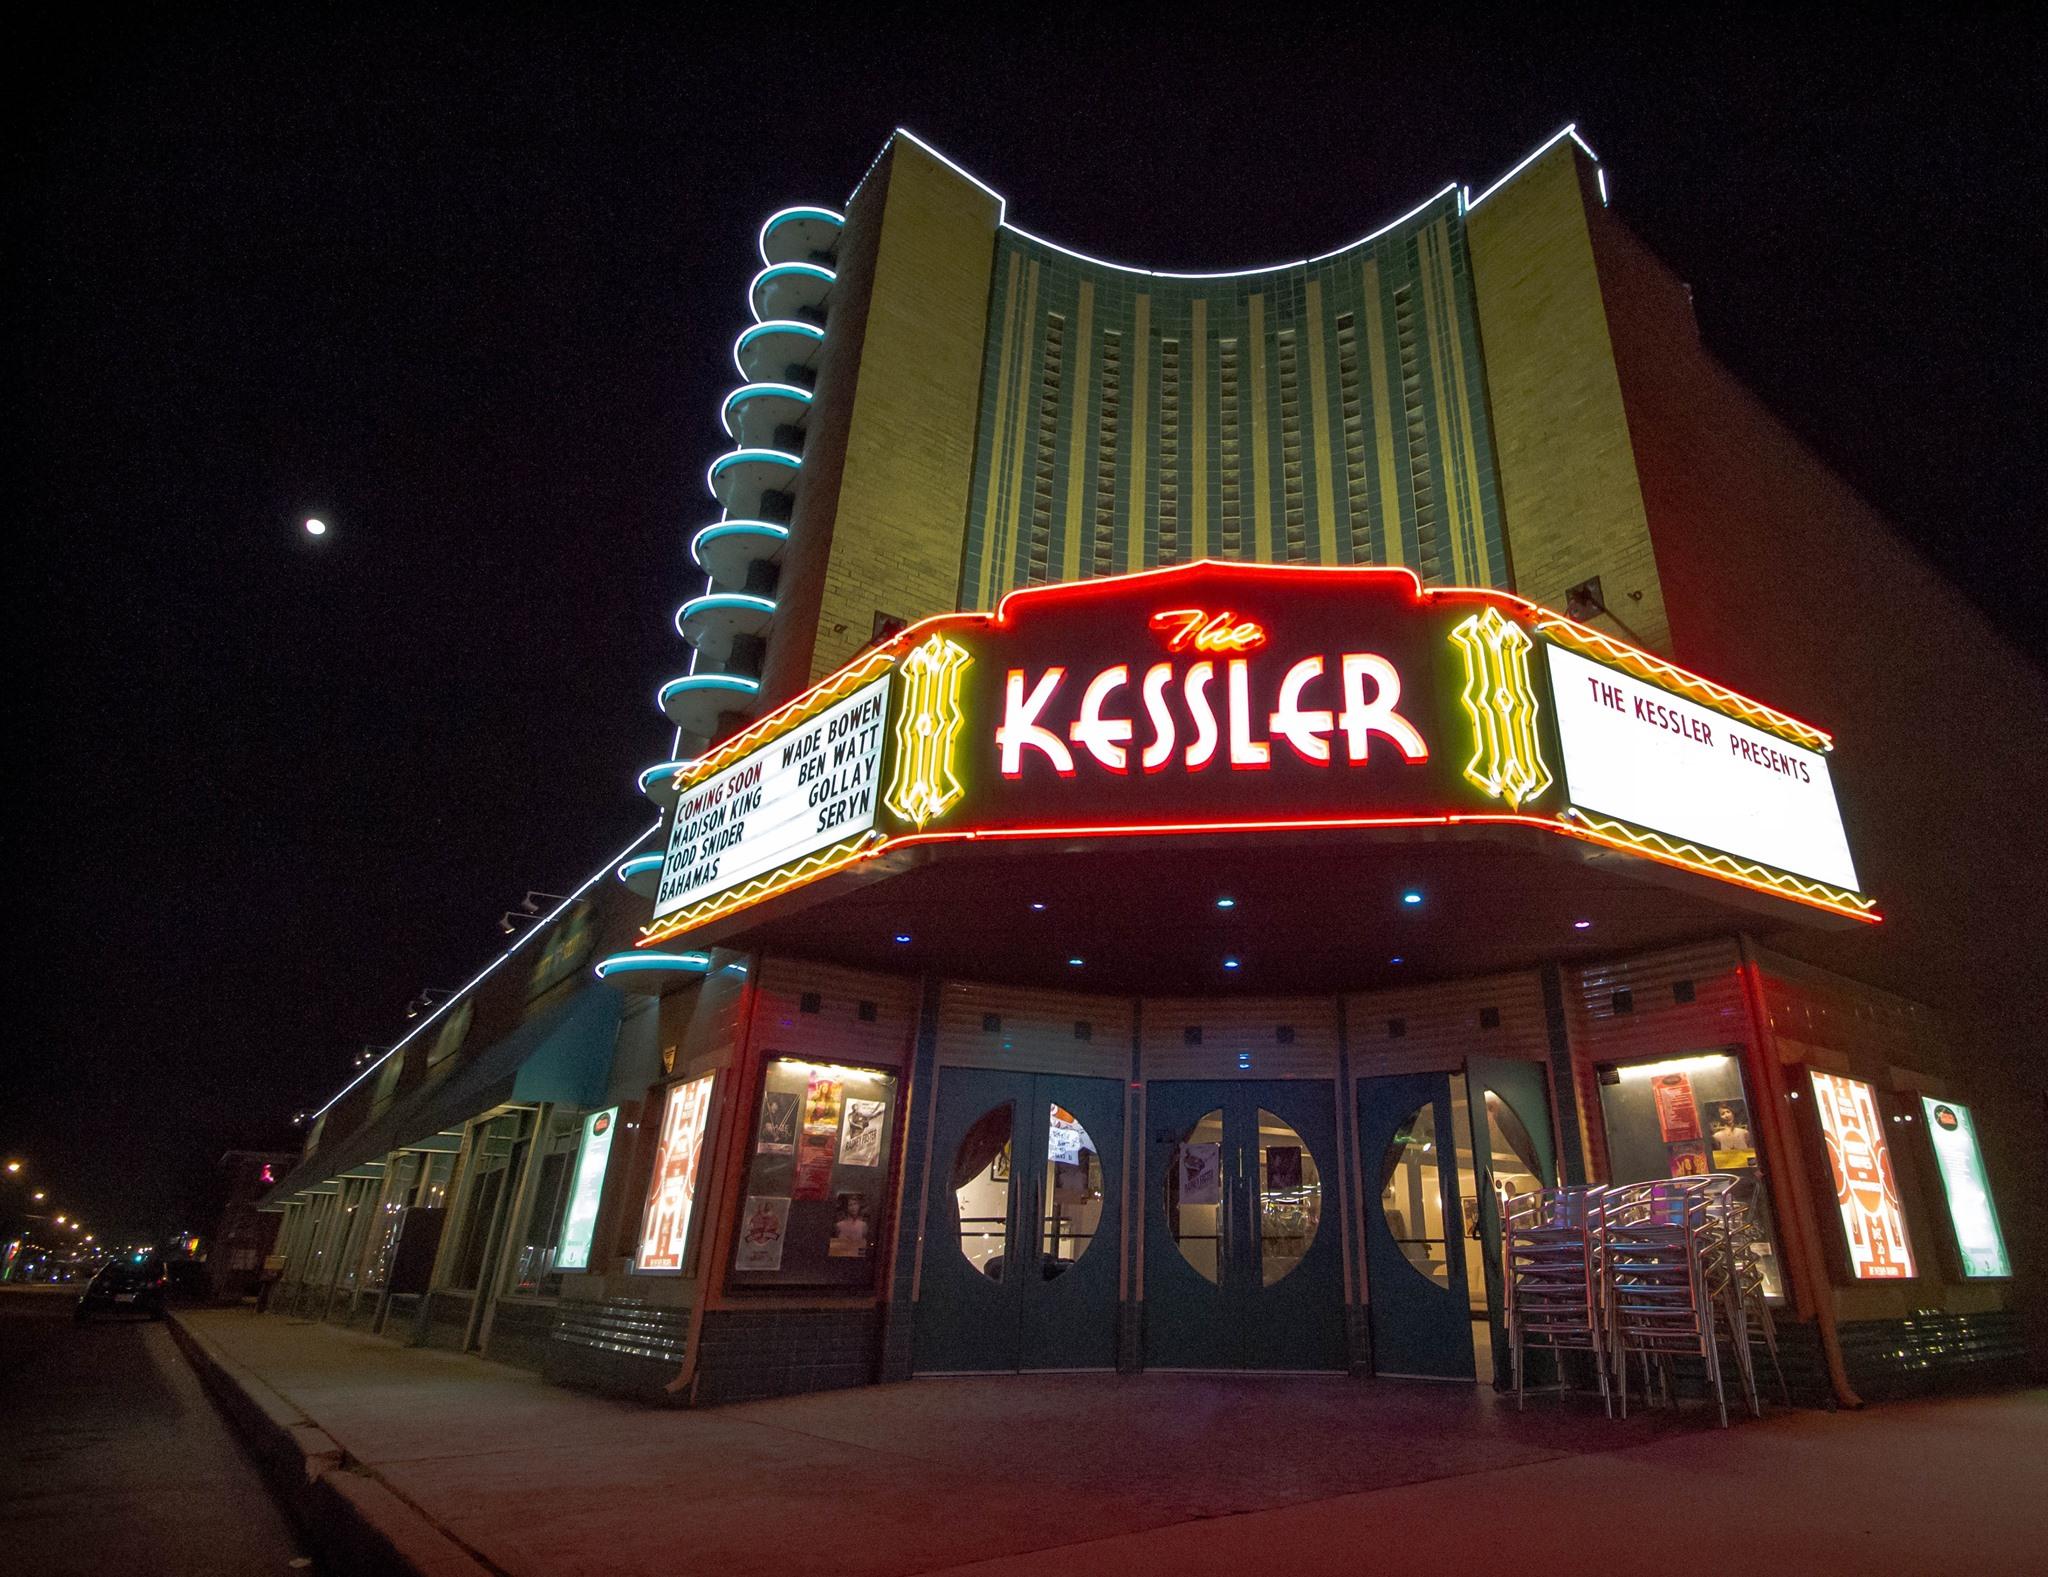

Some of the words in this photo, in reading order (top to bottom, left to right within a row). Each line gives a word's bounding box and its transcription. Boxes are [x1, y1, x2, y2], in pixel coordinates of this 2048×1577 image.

[1149, 609, 1266, 653] The
[782, 729, 822, 769] WADE
[828, 693, 882, 744] BOWEN
[995, 653, 1428, 780] KESSLER
[1588, 677, 1626, 713] THE
[1634, 696, 1714, 747] KESSLER
[1730, 734, 1811, 784] PRESENTS
[798, 753, 826, 787] BEN
[833, 724, 879, 767] WATT
[809, 754, 876, 808] GOLLAY
[671, 811, 724, 850] MADISON
[730, 787, 762, 821] KING
[677, 787, 723, 824] COMING
[727, 762, 762, 799] SOON
[817, 788, 870, 833] SERYN
[660, 858, 719, 902] BAHAMAS
[667, 849, 696, 876] TODD
[700, 822, 744, 858] SNIDER
